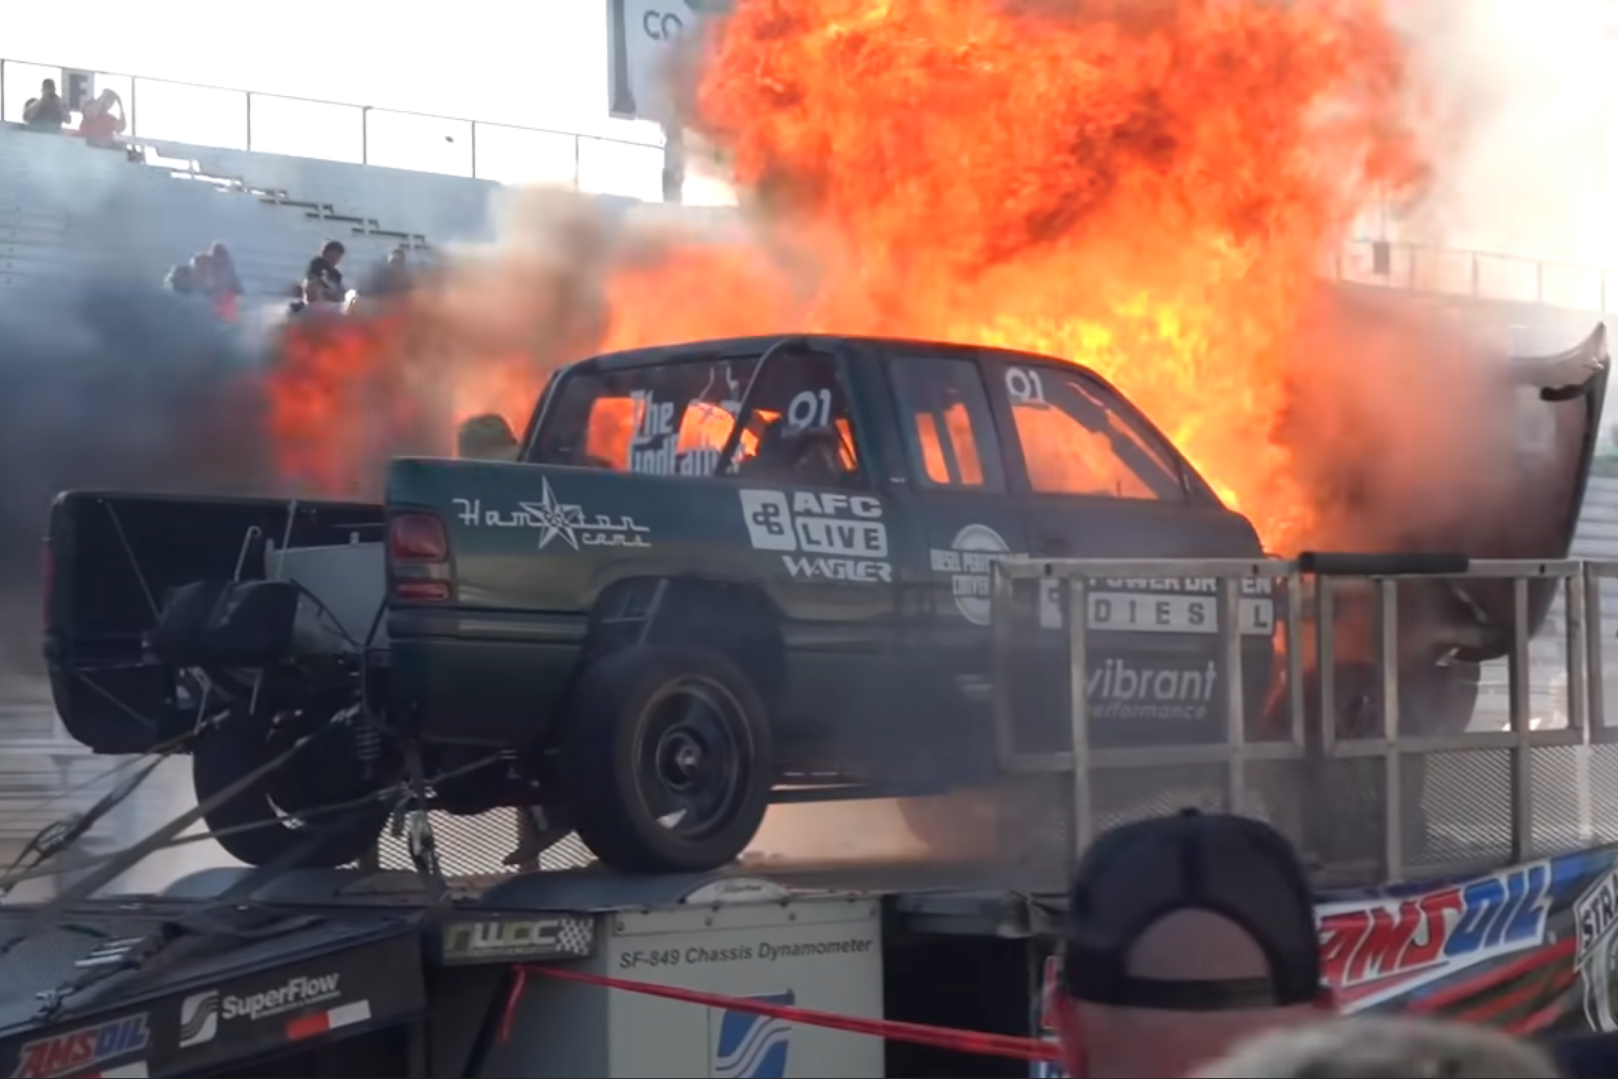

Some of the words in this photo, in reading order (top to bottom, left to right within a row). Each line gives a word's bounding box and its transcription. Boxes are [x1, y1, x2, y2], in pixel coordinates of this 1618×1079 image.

[788, 389, 831, 428] 01
[794, 491, 883, 518] AFC
[801, 522, 881, 551] LIVE
[781, 555, 892, 582] WAGLER
[1094, 600, 1268, 628] DIESL
[1092, 702, 1208, 719] erformance
[1318, 861, 1552, 986] AMSOIL
[619, 949, 681, 969] SF-849
[685, 944, 753, 965] Chassis
[758, 938, 874, 961] Dynamometer
[222, 973, 340, 1020] SuperFlow
[18, 1013, 149, 1079] AMSOIL
